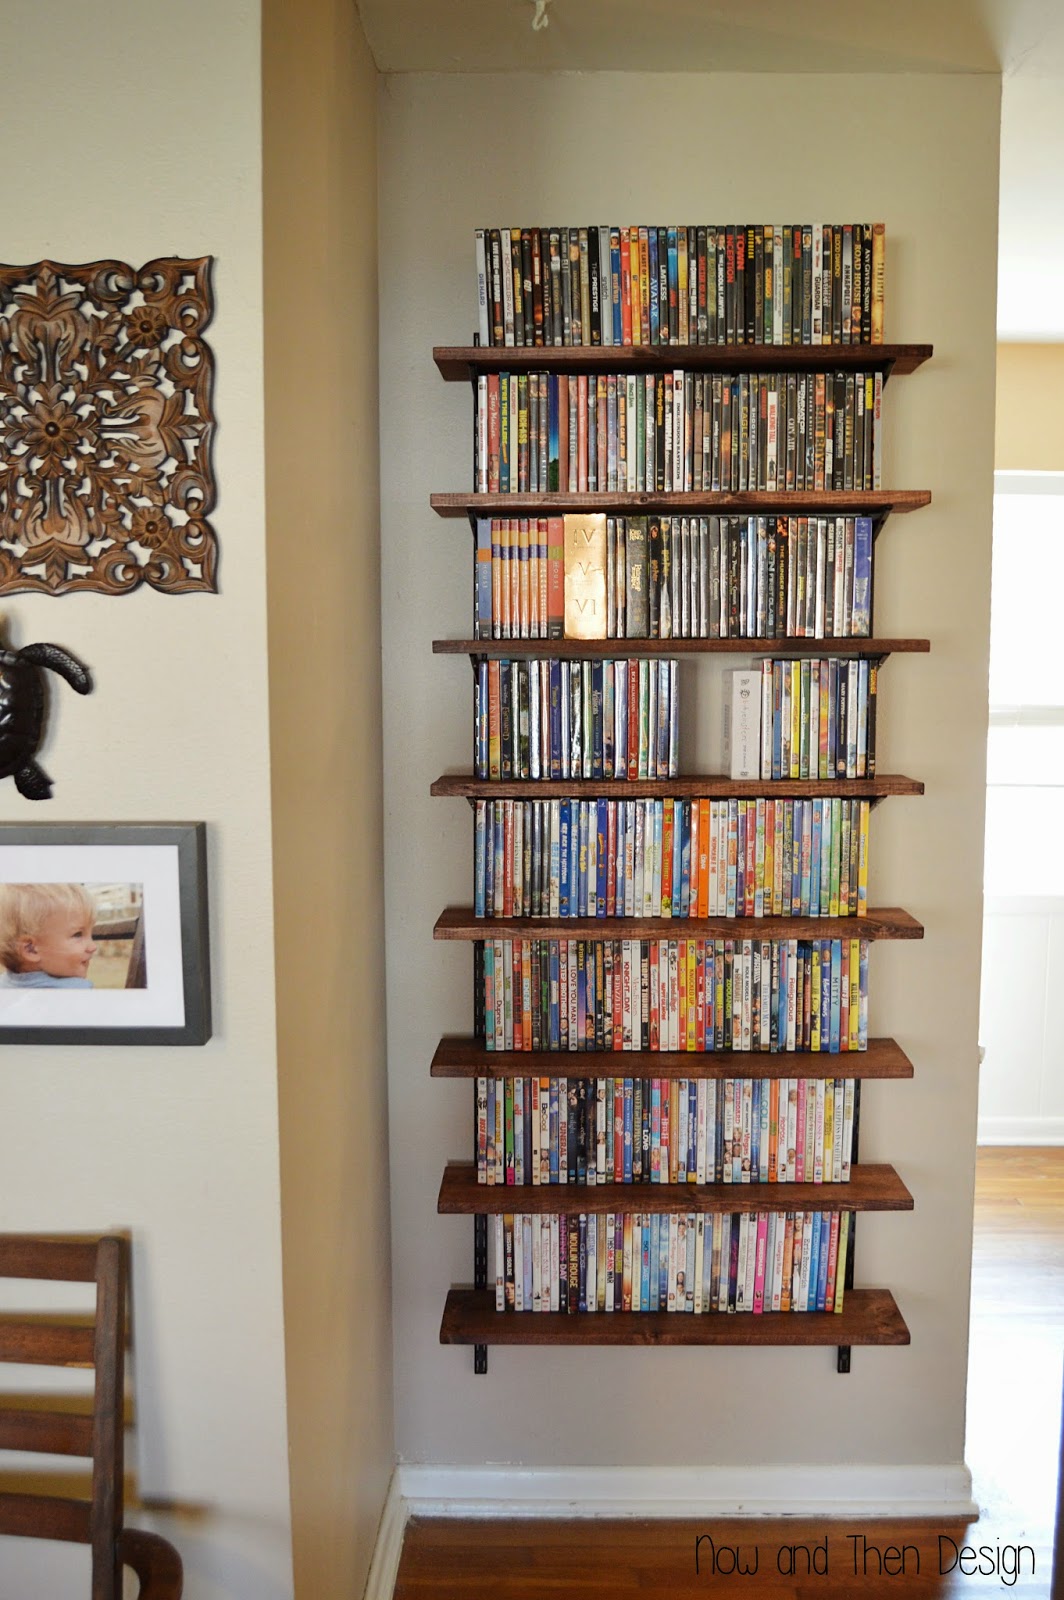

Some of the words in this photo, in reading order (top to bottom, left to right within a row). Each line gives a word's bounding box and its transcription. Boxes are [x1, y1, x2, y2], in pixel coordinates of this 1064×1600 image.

[726, 235, 734, 283] INCEPTION
[736, 234, 745, 270] TOWN
[650, 277, 658, 319] AVATAR
[519, 410, 527, 444] KICK-ASS
[573, 528, 596, 546] IV
[578, 562, 592, 576] V
[490, 694, 498, 715] LION
[490, 716, 498, 736] KING
[711, 866, 716, 874] ME
[689, 997, 695, 1005] UP
[542, 1103, 548, 1114] Be
[742, 1133, 750, 1156] Vegas
[570, 1233, 578, 1262] MOULIN
[829, 1229, 837, 1266] STEPMOM
[570, 1263, 578, 1288] ROUGE
[801, 1256, 809, 1289] Brockovich
